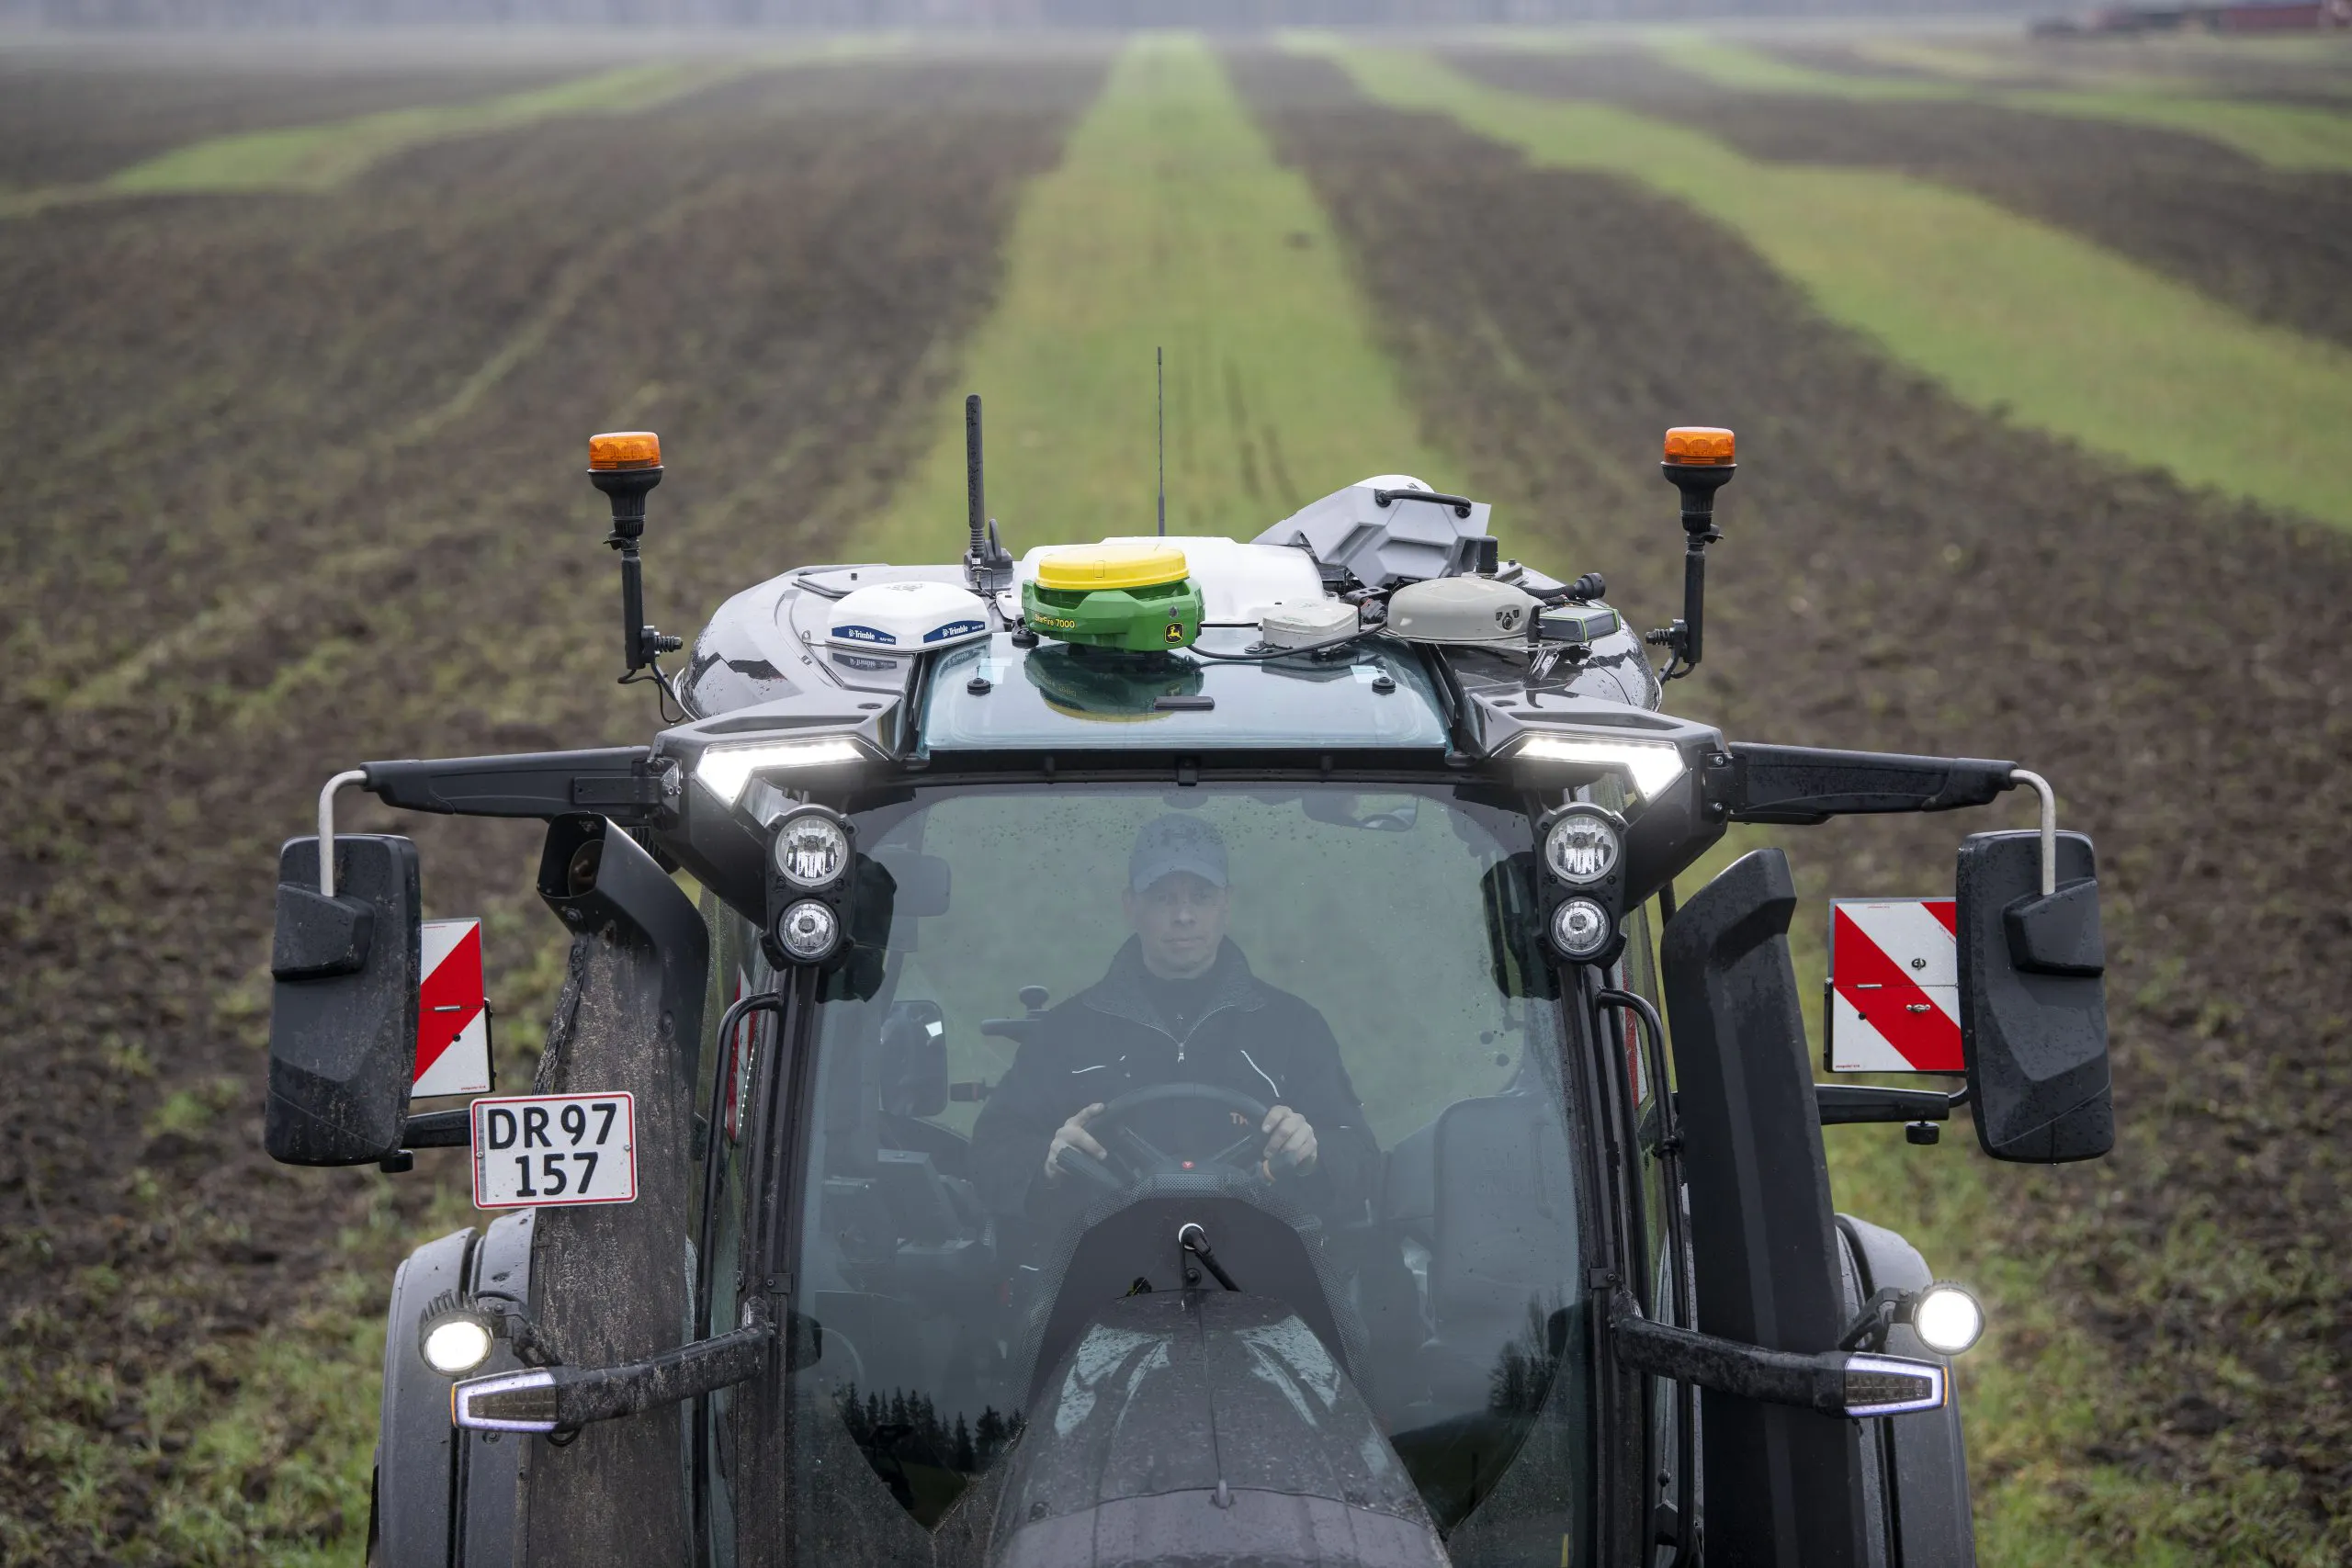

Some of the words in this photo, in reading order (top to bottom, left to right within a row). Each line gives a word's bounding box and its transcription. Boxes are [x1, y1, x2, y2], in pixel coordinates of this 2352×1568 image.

[1055, 618, 1075, 628] 7000
[854, 629, 876, 640] Trimble
[948, 625, 968, 636] Trimble
[515, 1152, 598, 1197] 157
